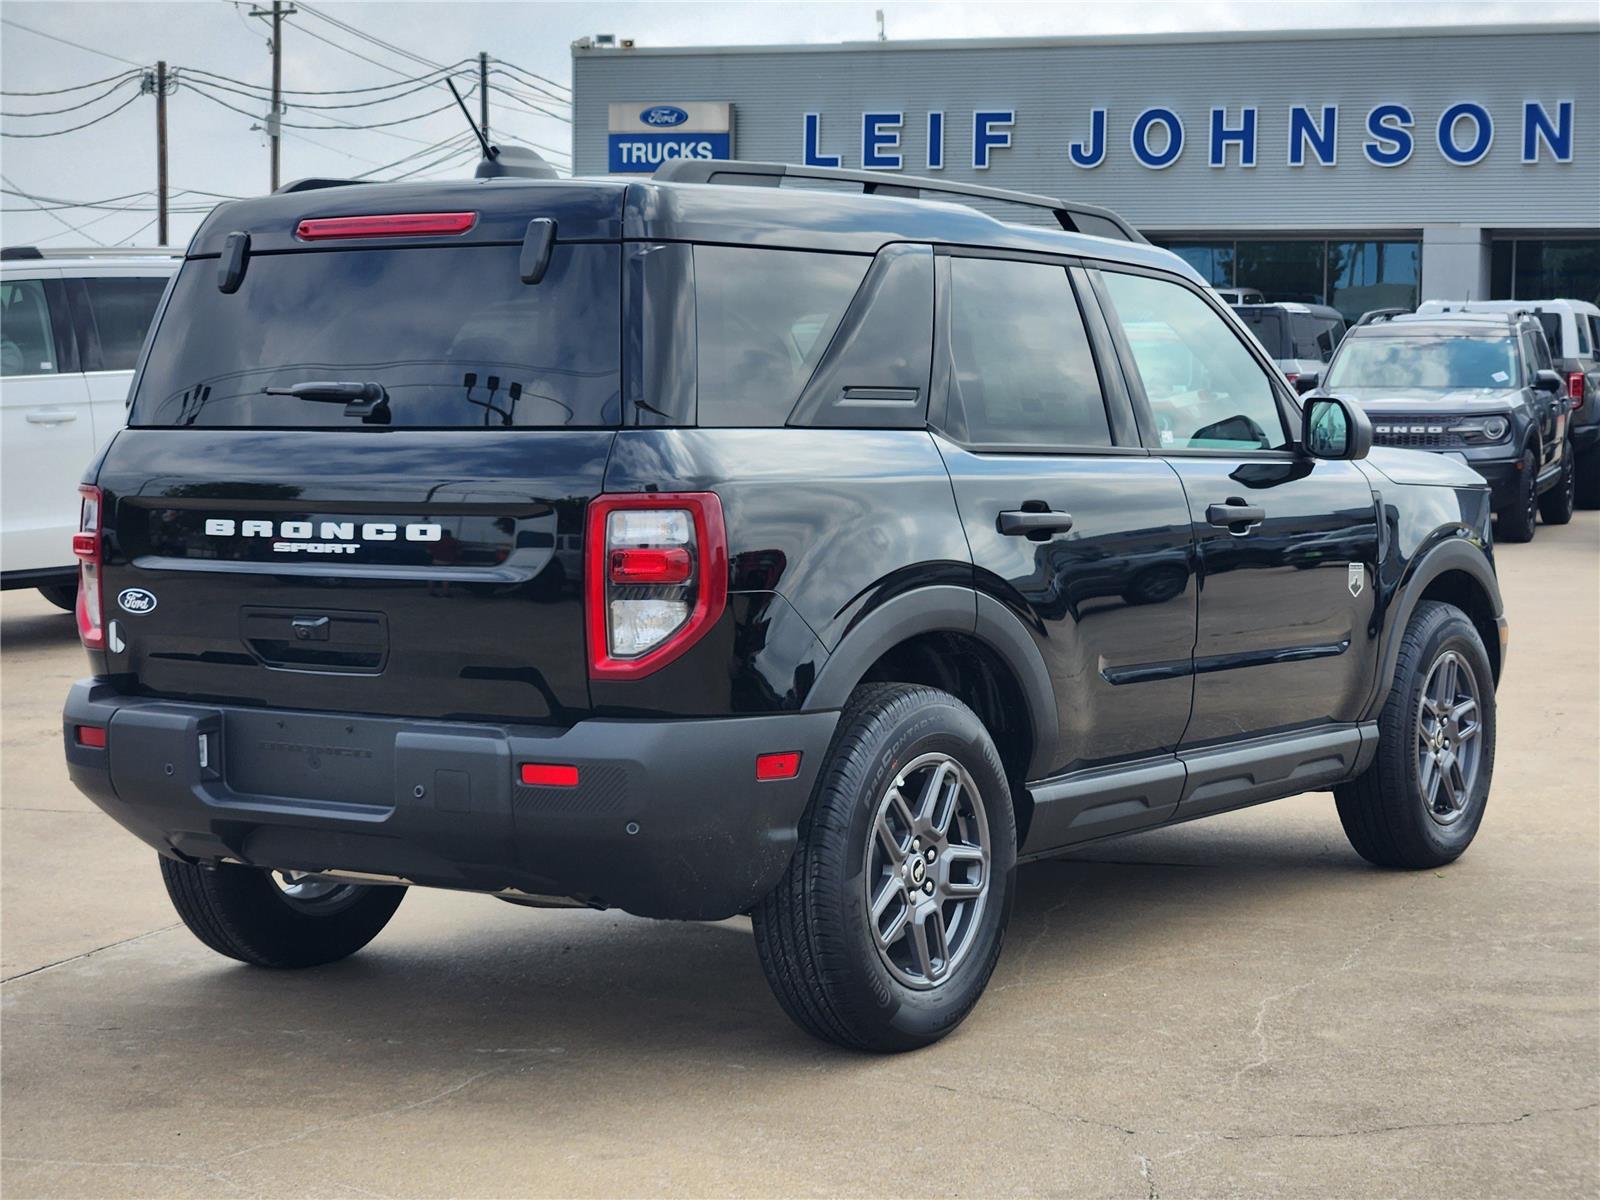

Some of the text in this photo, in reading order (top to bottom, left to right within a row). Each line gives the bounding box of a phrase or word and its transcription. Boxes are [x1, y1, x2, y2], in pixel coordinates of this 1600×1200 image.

[646, 109, 679, 124] Ford
[803, 100, 1575, 169] LEIF JOHNSON
[618, 141, 712, 163] TRUCKS
[1376, 425, 1442, 433] ONCO
[205, 518, 442, 541] BRONCO
[273, 542, 361, 554] SPORT
[123, 591, 151, 610] Ford
